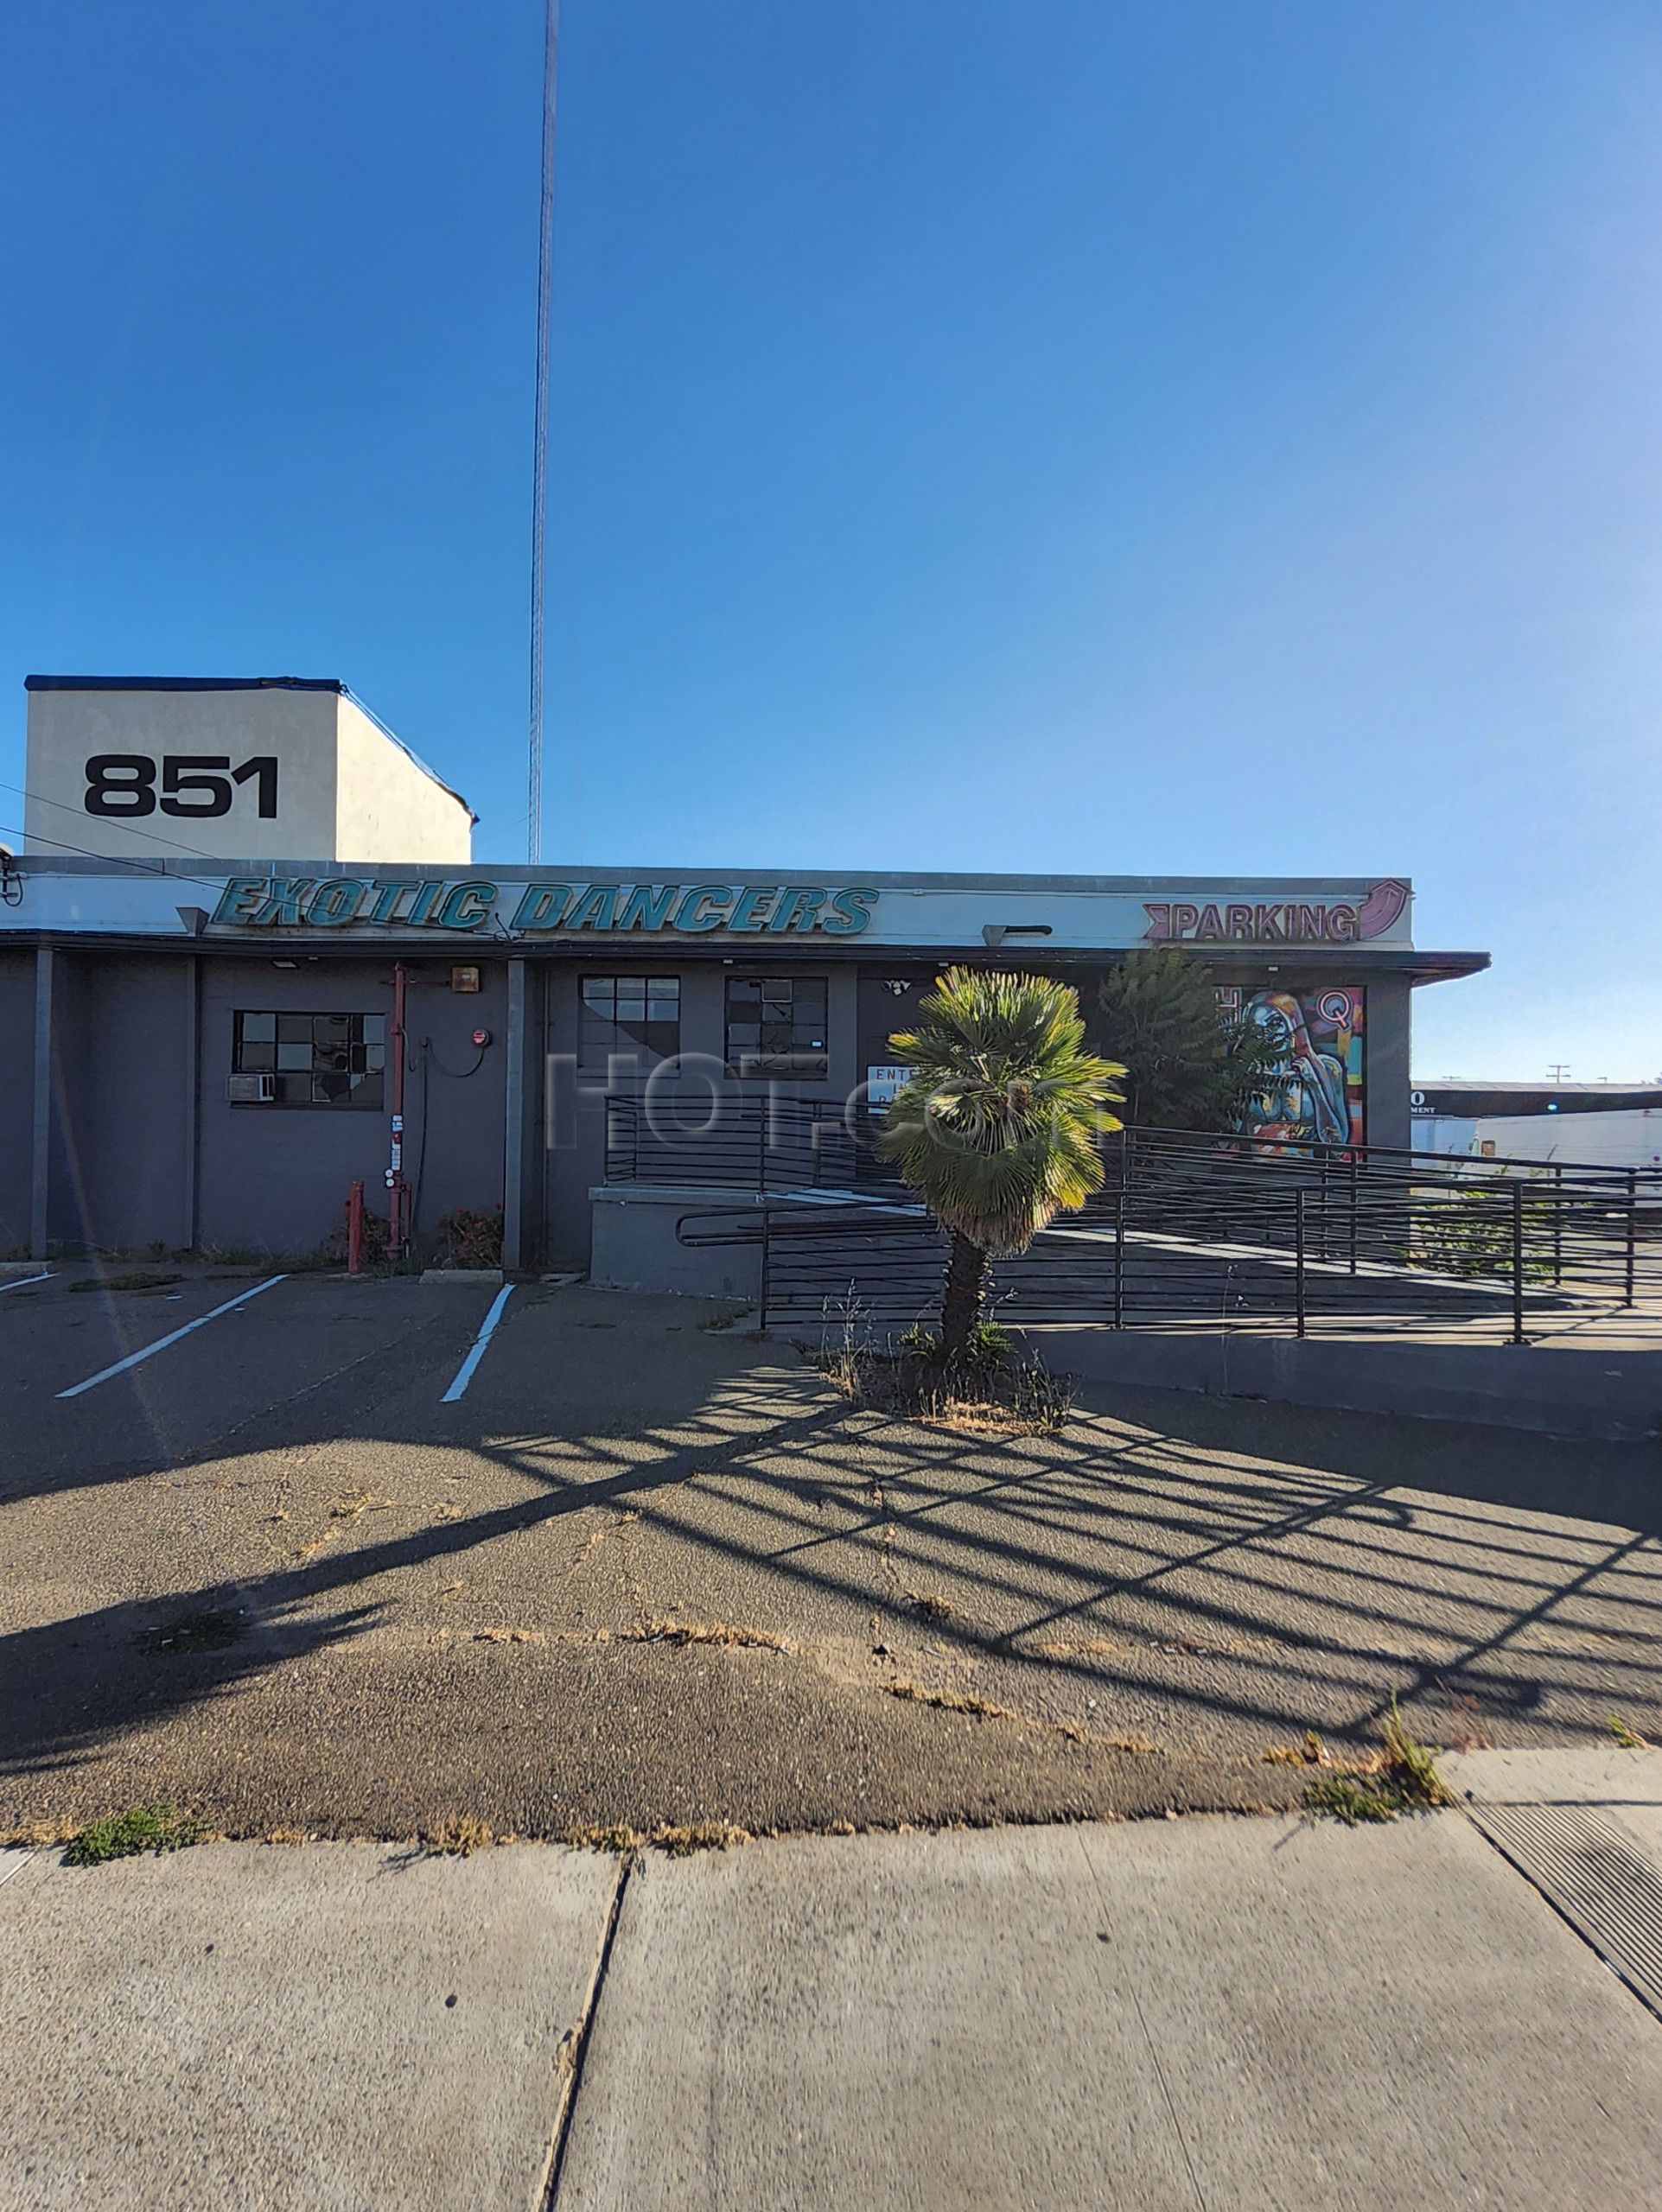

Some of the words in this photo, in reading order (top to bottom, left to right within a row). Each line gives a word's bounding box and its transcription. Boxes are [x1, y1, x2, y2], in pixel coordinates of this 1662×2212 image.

[85, 754, 278, 818] 851
[210, 877, 499, 929] EXOTIC
[509, 883, 880, 935] DANCERS
[1171, 903, 1358, 942] PARKING
[1316, 989, 1353, 1032] Q
